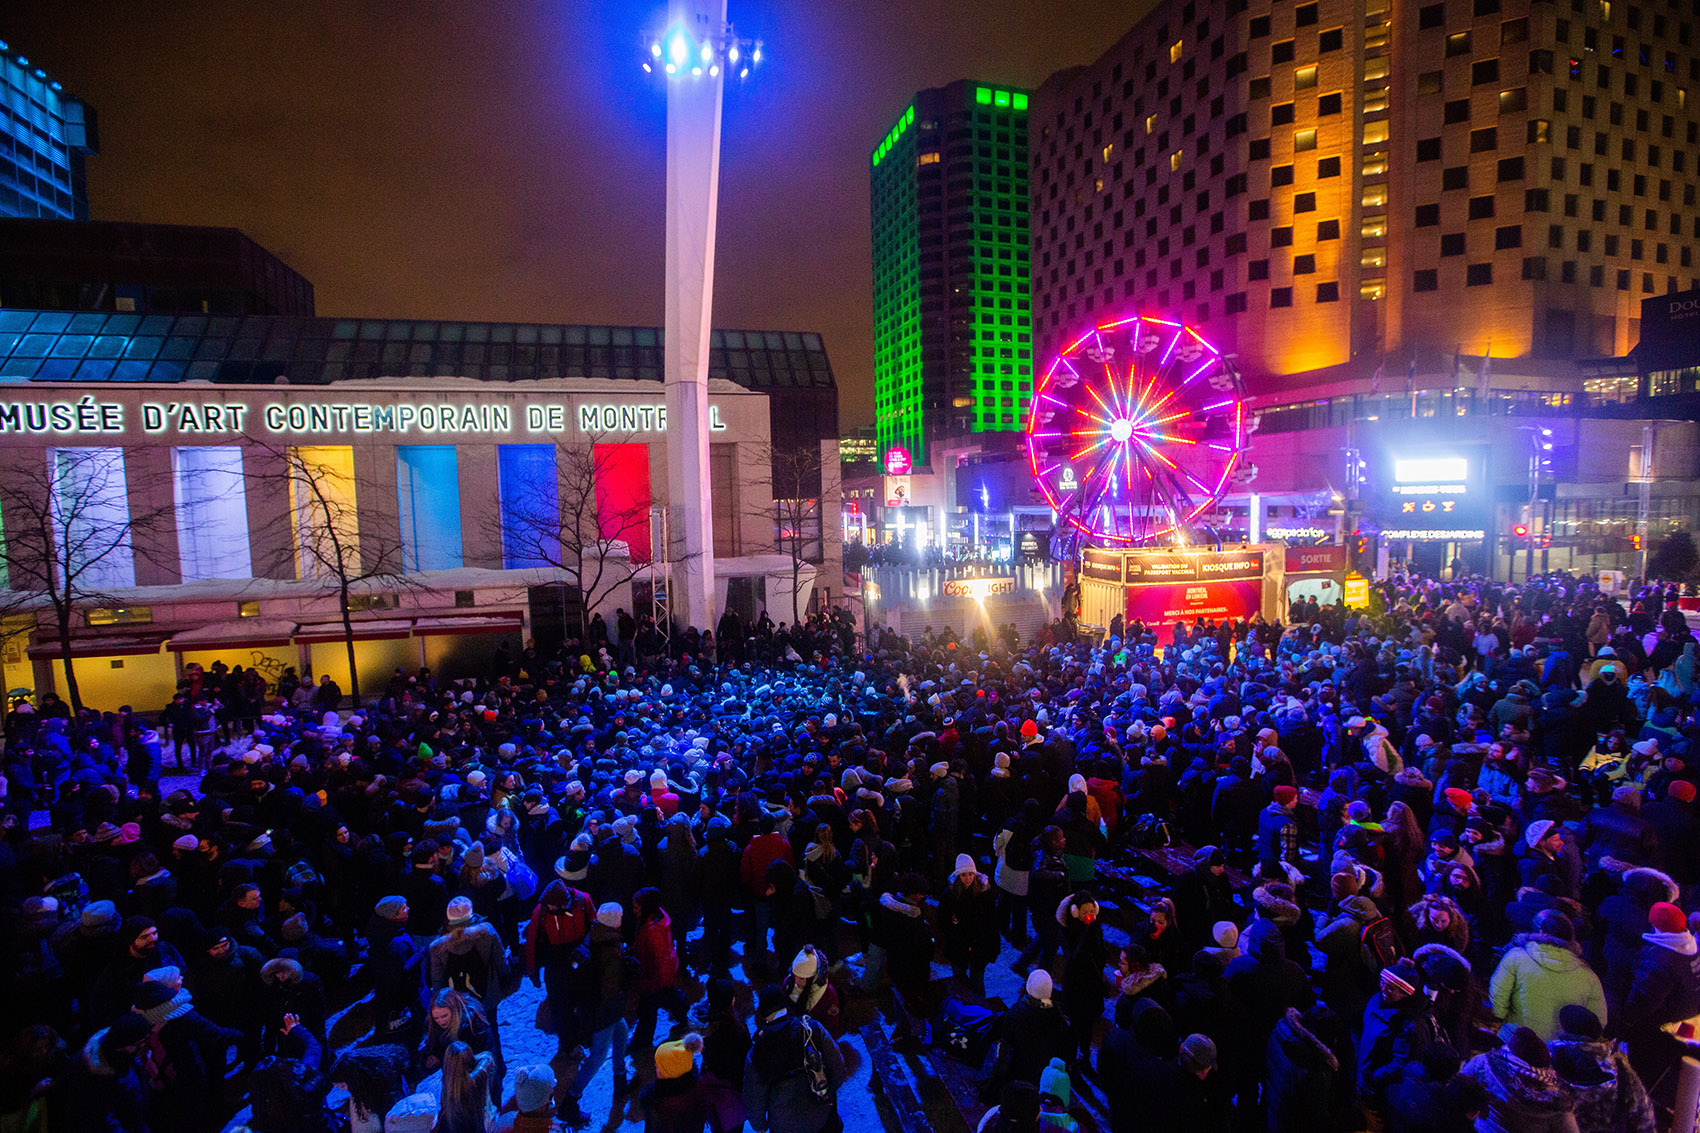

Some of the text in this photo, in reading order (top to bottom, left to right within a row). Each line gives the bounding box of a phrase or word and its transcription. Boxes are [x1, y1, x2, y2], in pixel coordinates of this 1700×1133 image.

[0, 396, 726, 433] MUSÉE D'ART CONTEMPORAIN DE MONTRL
[1301, 554, 1331, 564] SORTIE
[1202, 562, 1234, 573] KIOSQUE
[1234, 561, 1250, 570] INFO
[983, 582, 1014, 593] IGHT
